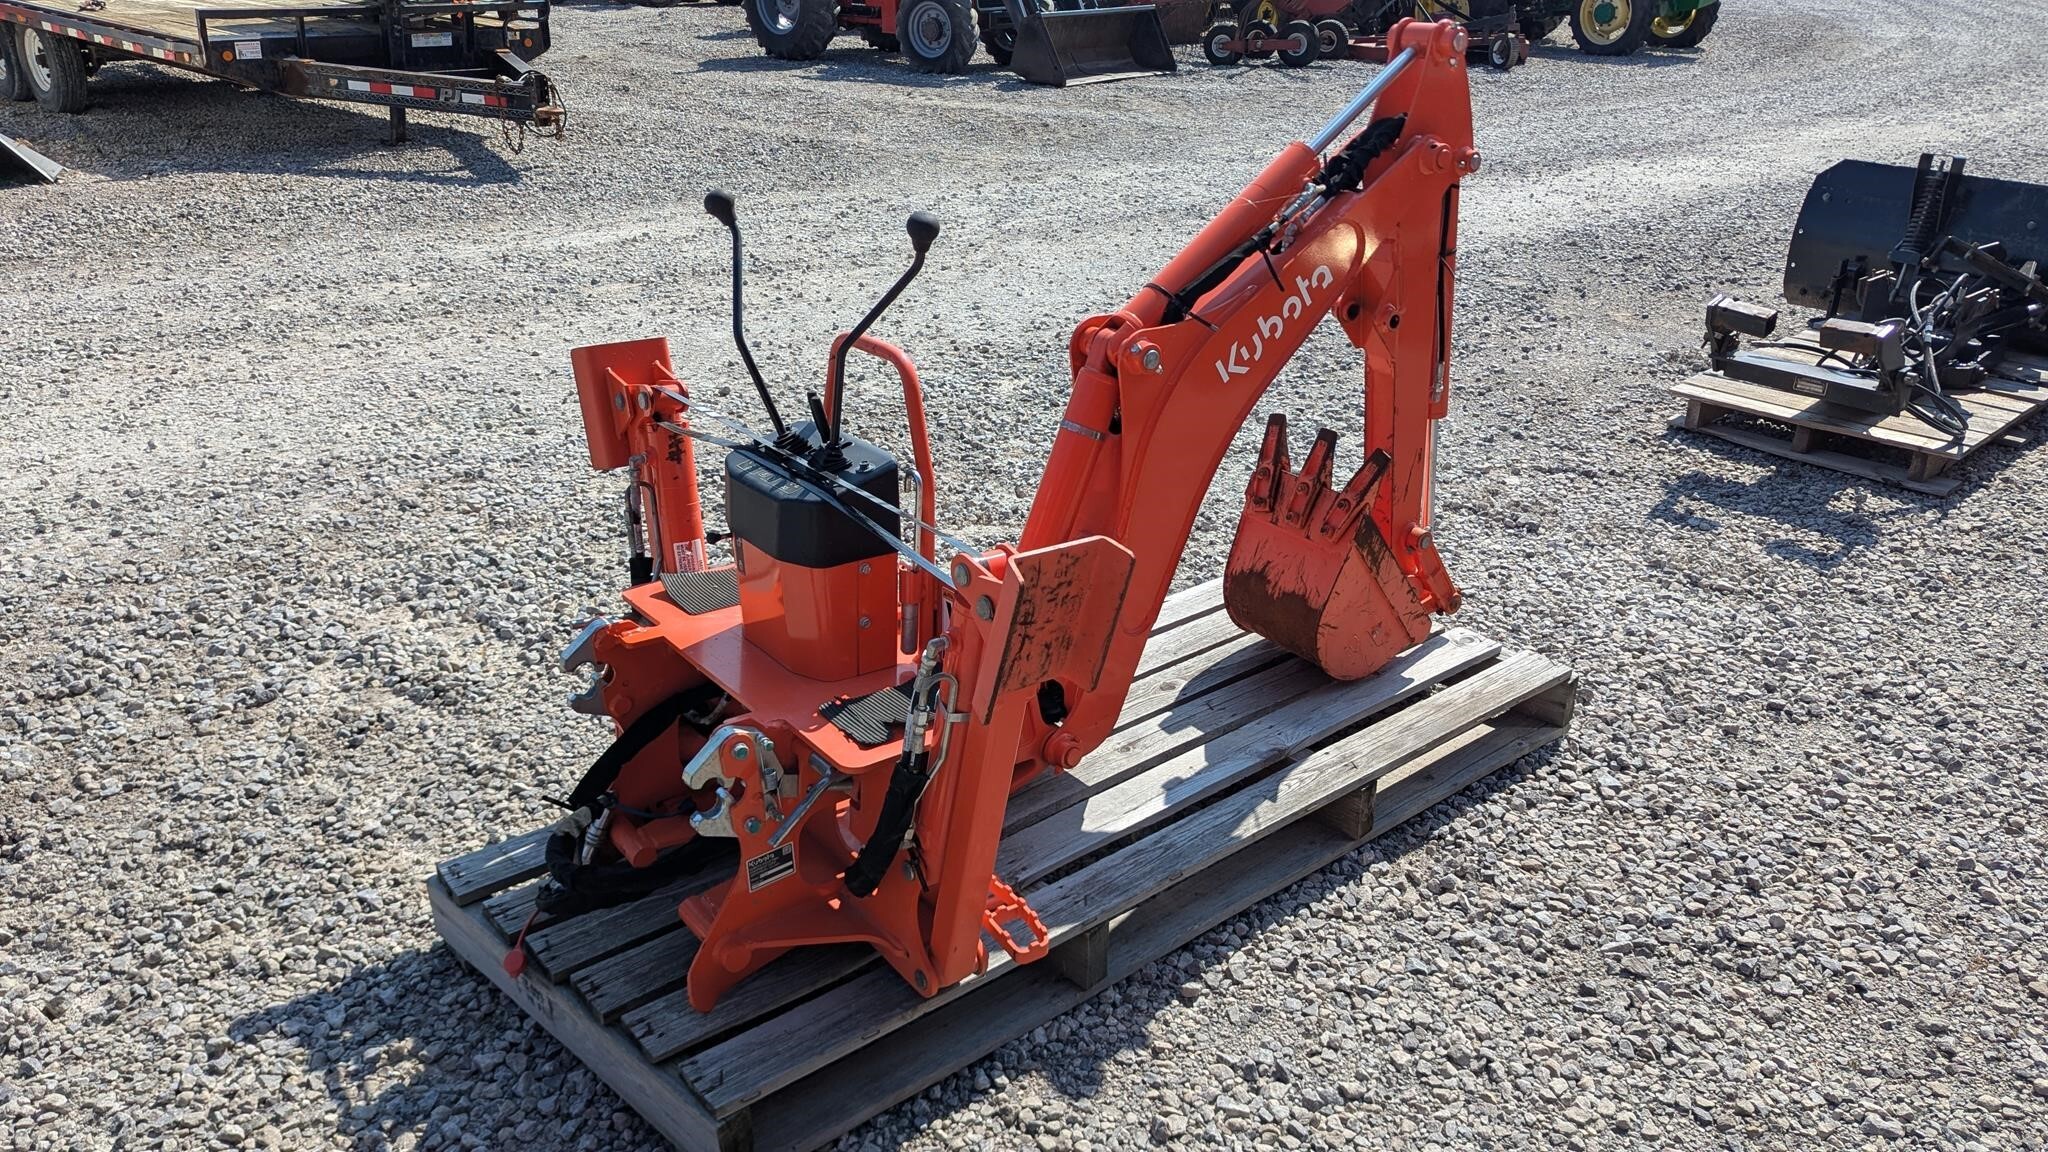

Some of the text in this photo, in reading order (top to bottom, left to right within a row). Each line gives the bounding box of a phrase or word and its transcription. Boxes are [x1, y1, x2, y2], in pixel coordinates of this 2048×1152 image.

[440, 88, 461, 103] PJ
[1215, 265, 1333, 383] Kubota
[748, 853, 775, 867] Kubota
